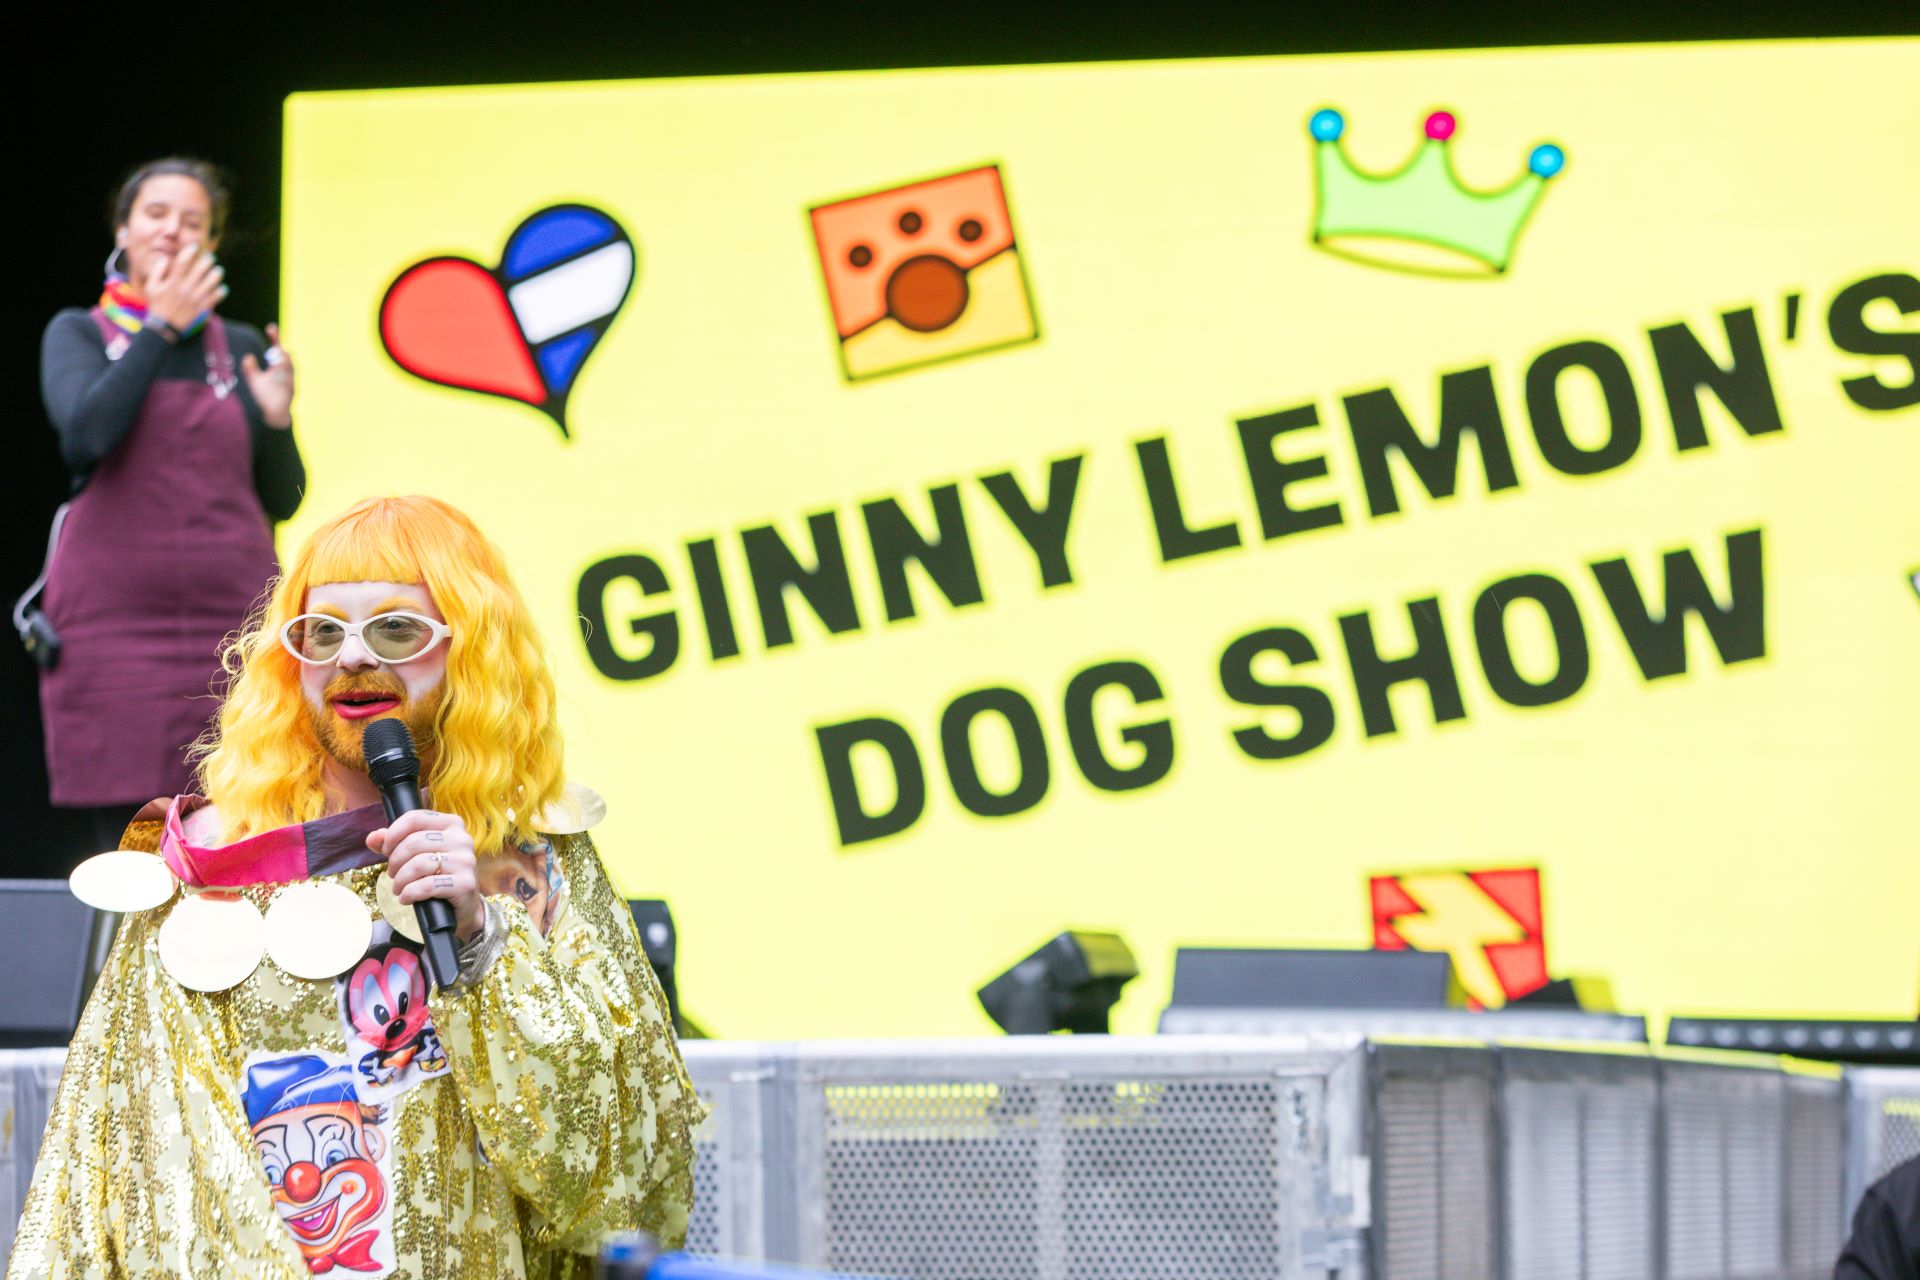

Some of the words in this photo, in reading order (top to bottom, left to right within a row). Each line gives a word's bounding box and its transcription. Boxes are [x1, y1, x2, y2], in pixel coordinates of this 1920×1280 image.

[577, 455, 1083, 682] GINNY
[1136, 273, 1920, 562] LEMON'S
[816, 661, 1174, 845] DOG
[1220, 529, 1766, 760] SHOW
